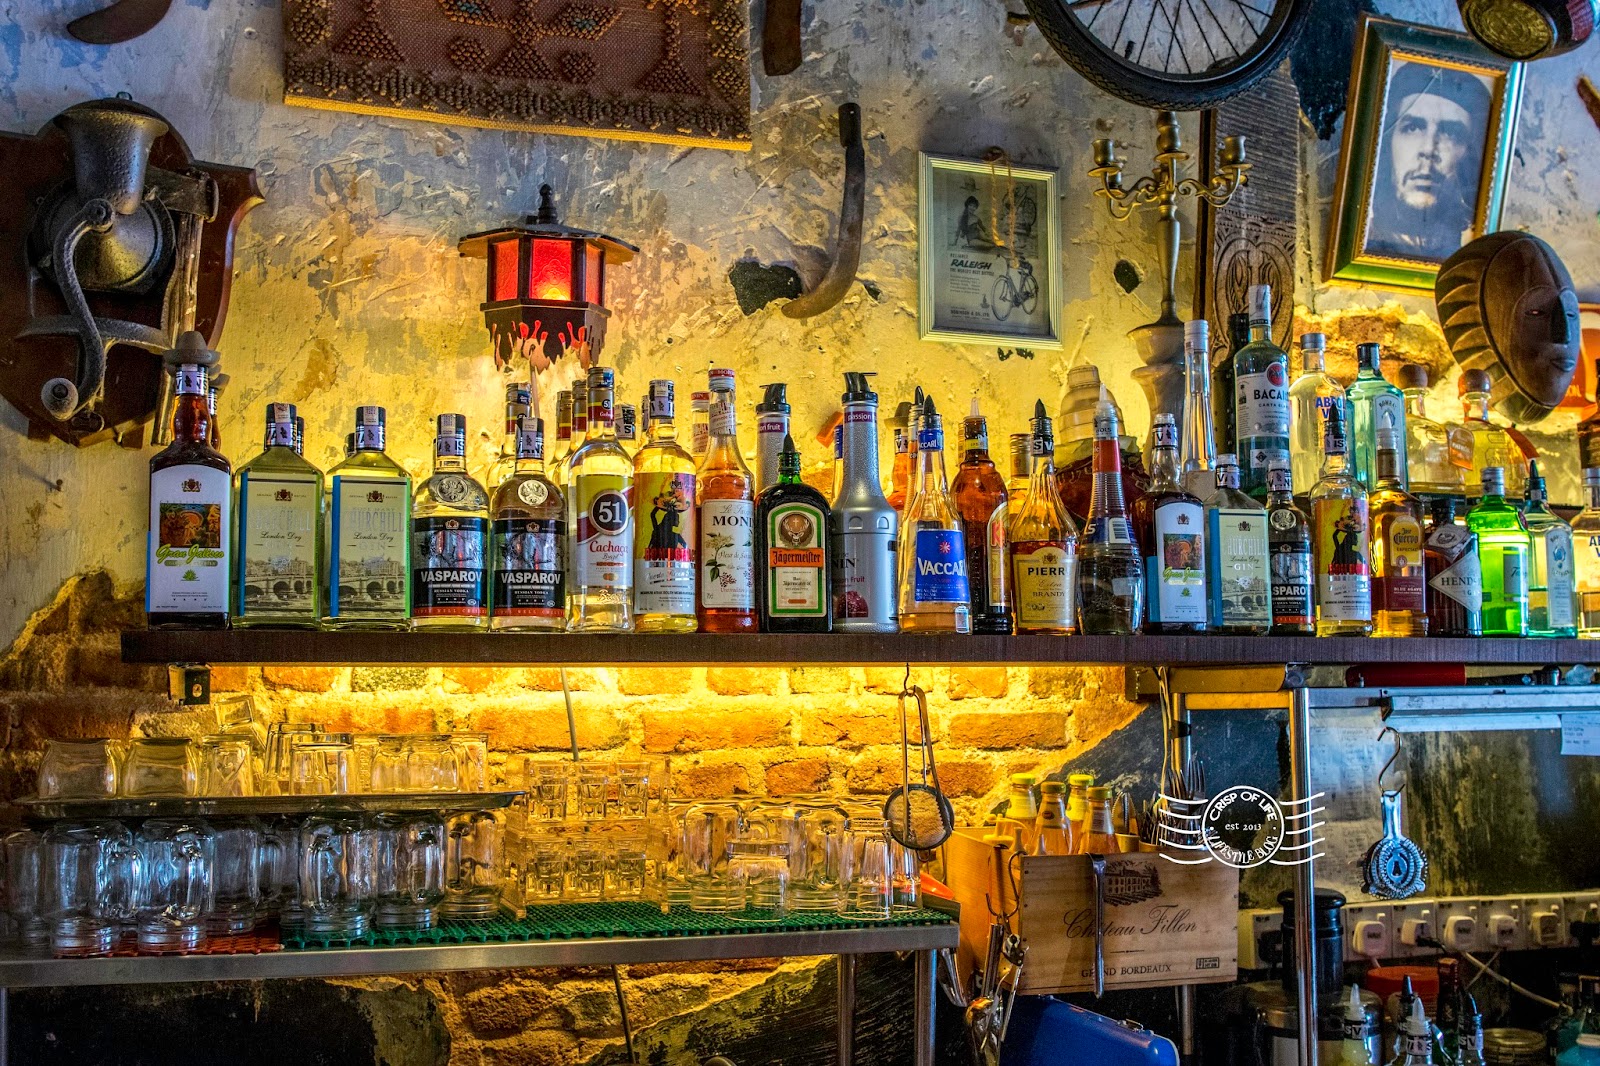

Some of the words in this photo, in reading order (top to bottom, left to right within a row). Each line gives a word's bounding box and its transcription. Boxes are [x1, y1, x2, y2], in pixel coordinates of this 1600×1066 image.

[950, 258, 992, 270] RALEIGH
[847, 413, 872, 422] passion
[767, 423, 780, 431] fruit
[598, 501, 622, 523] 51
[260, 531, 285, 540] London
[286, 531, 302, 543] Dry
[353, 531, 378, 540] London
[379, 532, 395, 543] Dry
[155, 543, 187, 564] Gran
[772, 550, 821, 565] Jägermeister
[917, 557, 967, 577] VACCARI
[1027, 567, 1066, 576] PIERR
[1233, 562, 1255, 571] GIN
[420, 570, 482, 582] VASPAROV
[500, 572, 561, 584] VASPAROV
[850, 575, 865, 583] Fruit
[1272, 585, 1307, 596] SPARO
[1063, 908, 1136, 939] Chteau
[1140, 904, 1198, 935] Fillon
[1081, 966, 1117, 979] GND
[1120, 964, 1172, 976] BORDEAUX
